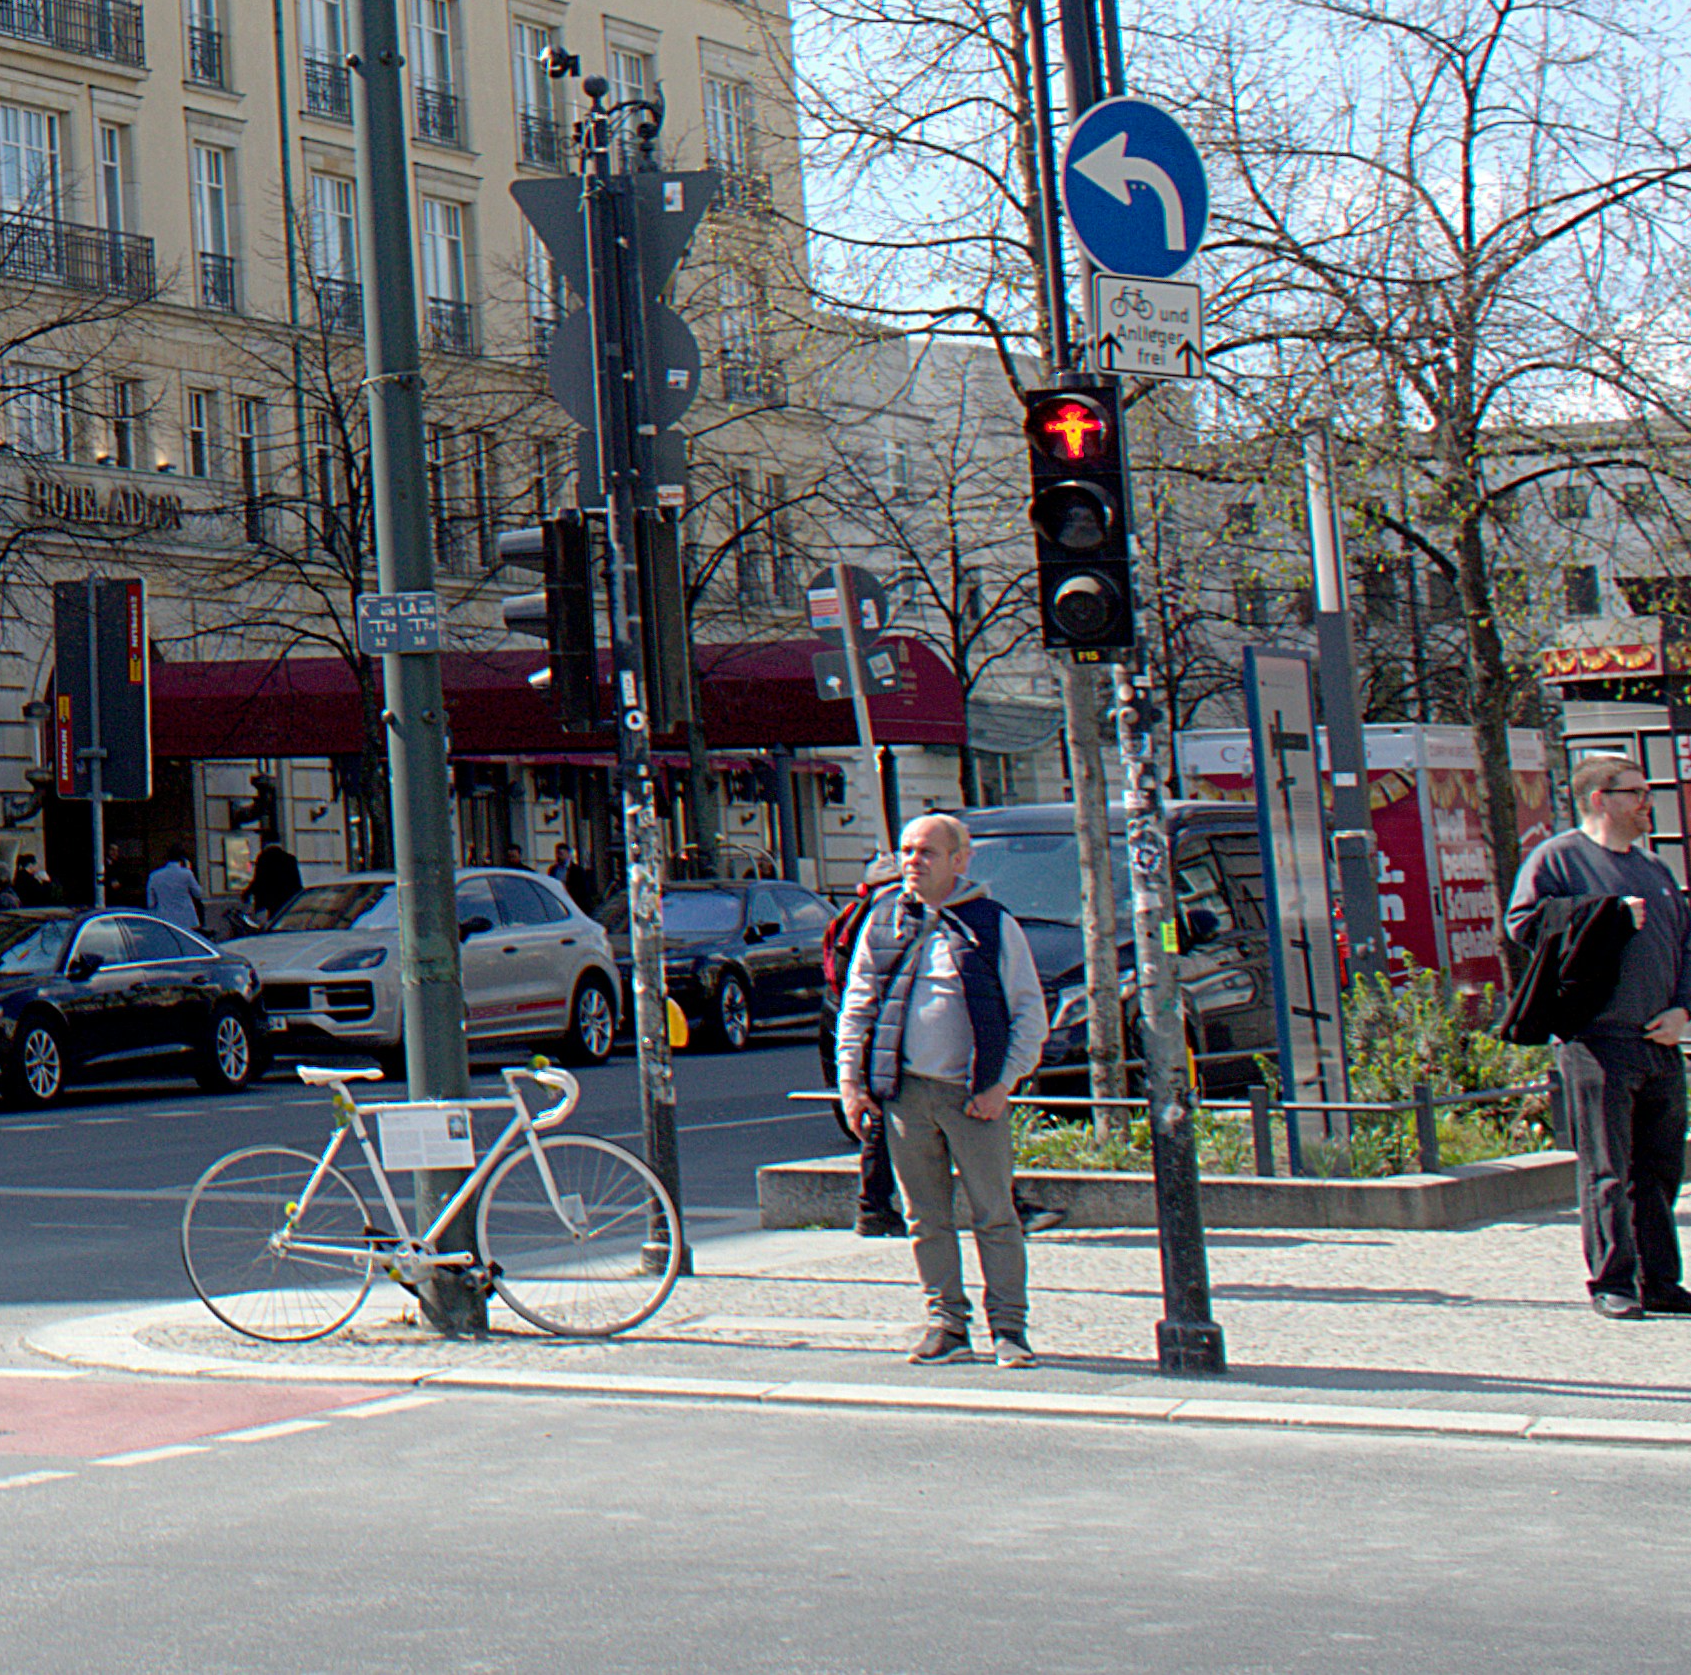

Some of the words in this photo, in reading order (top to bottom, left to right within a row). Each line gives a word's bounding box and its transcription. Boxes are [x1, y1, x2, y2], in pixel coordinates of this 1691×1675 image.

[1159, 307, 1190, 324] und
[1116, 323, 1184, 348] Anlieger
[1138, 347, 1166, 366] frei
[27, 479, 107, 524] HOTEL
[1078, 651, 1100, 662] F15
